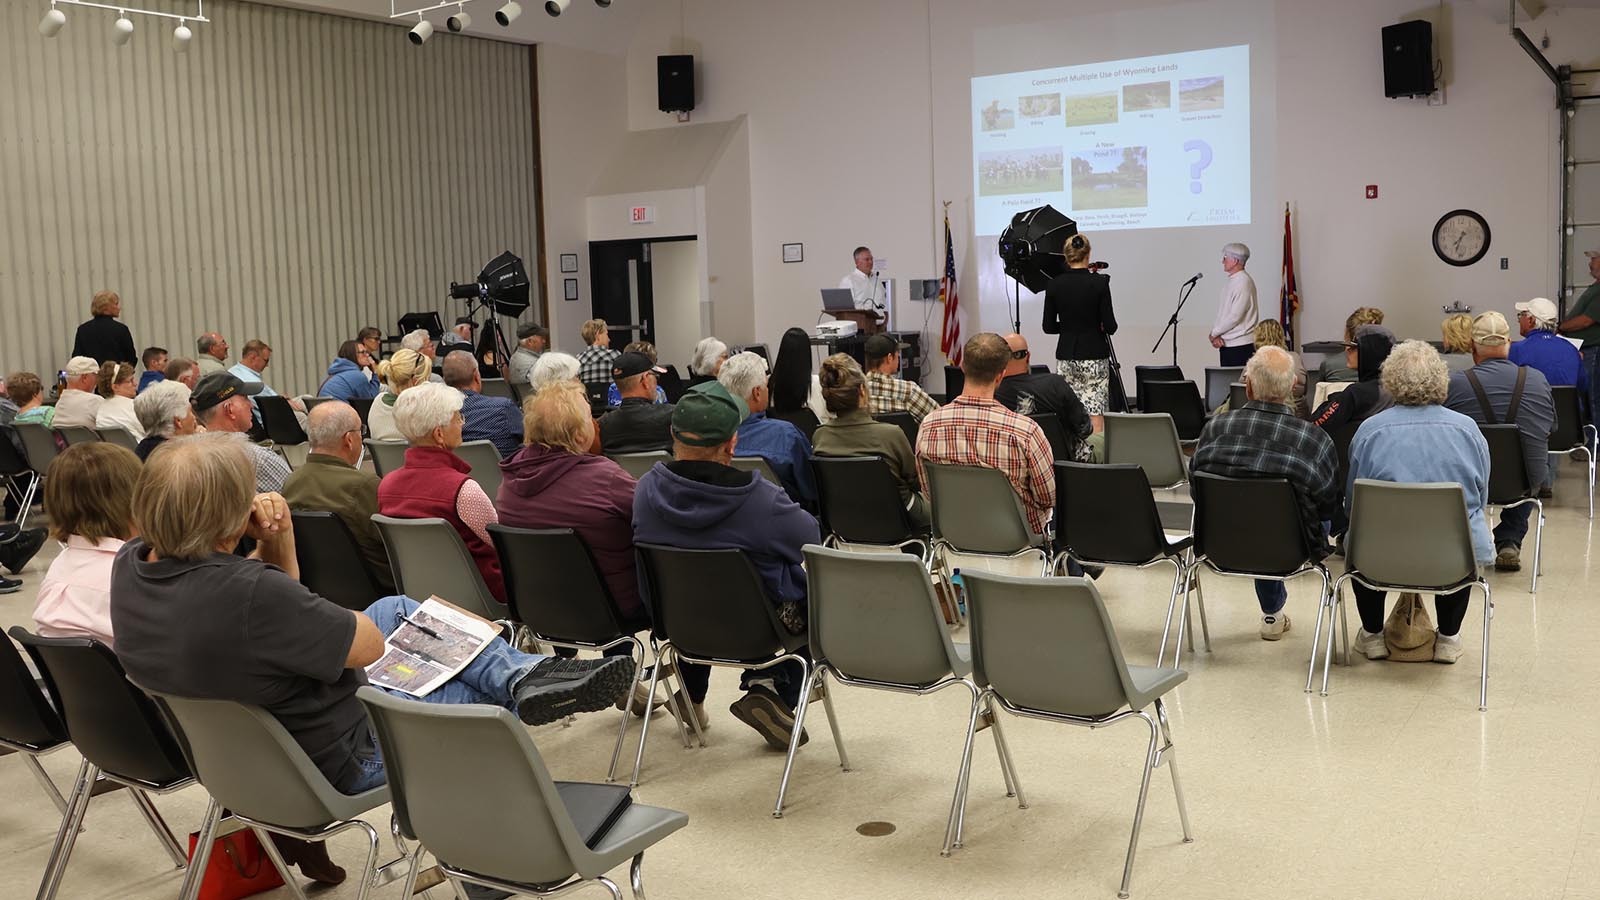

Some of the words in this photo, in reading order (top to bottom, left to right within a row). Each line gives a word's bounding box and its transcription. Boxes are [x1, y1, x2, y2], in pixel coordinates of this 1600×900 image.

[1031, 75, 1069, 87] Concurrent
[1069, 71, 1098, 83] Multiple
[1099, 70, 1112, 79] Use
[1113, 69, 1122, 77] of
[1122, 66, 1156, 78] Wyoming
[1157, 63, 1178, 73] Lands
[633, 207, 646, 221] EXIT
[1314, 401, 1340, 427] IMMS
